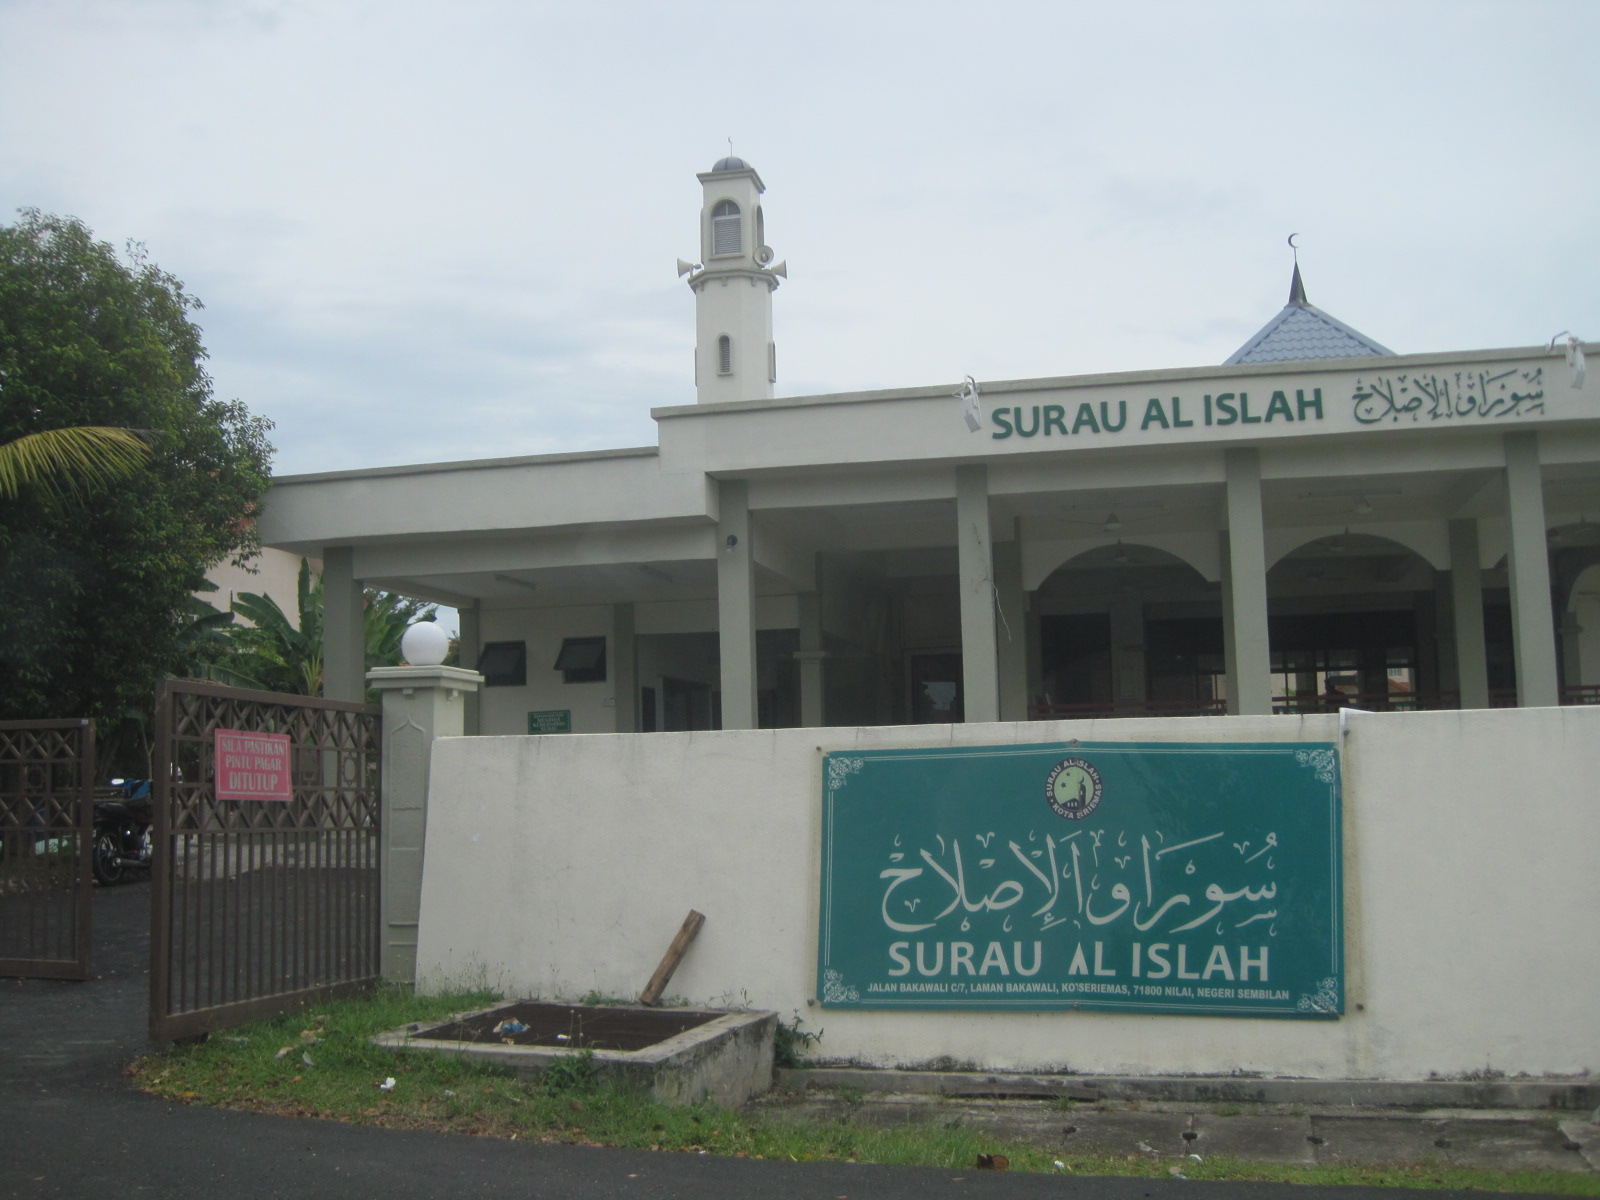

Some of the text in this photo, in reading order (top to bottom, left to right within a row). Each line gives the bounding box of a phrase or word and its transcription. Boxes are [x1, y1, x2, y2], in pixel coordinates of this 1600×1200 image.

[991, 388, 1324, 440] SURAU AL ISLAH
[223, 739, 284, 756] SILA PASTIKAN
[226, 755, 282, 771] PINTU PAGAR
[229, 772, 278, 791] DITUTUP
[1046, 765, 1061, 797] SURAU
[1052, 803, 1075, 819] KOTA
[888, 942, 1270, 982] SURAU AL ISLAH
[867, 982, 898, 992] JALAN
[899, 983, 949, 993] BAKAWALI
[970, 983, 1004, 993] LAMAN
[1006, 983, 1059, 995] BAKAWALI,
[1133, 985, 1163, 996] 71800
[1165, 986, 1195, 998] NILAI,
[1197, 987, 1235, 998] NEGERI
[1237, 988, 1290, 1000] SEMBILAN
